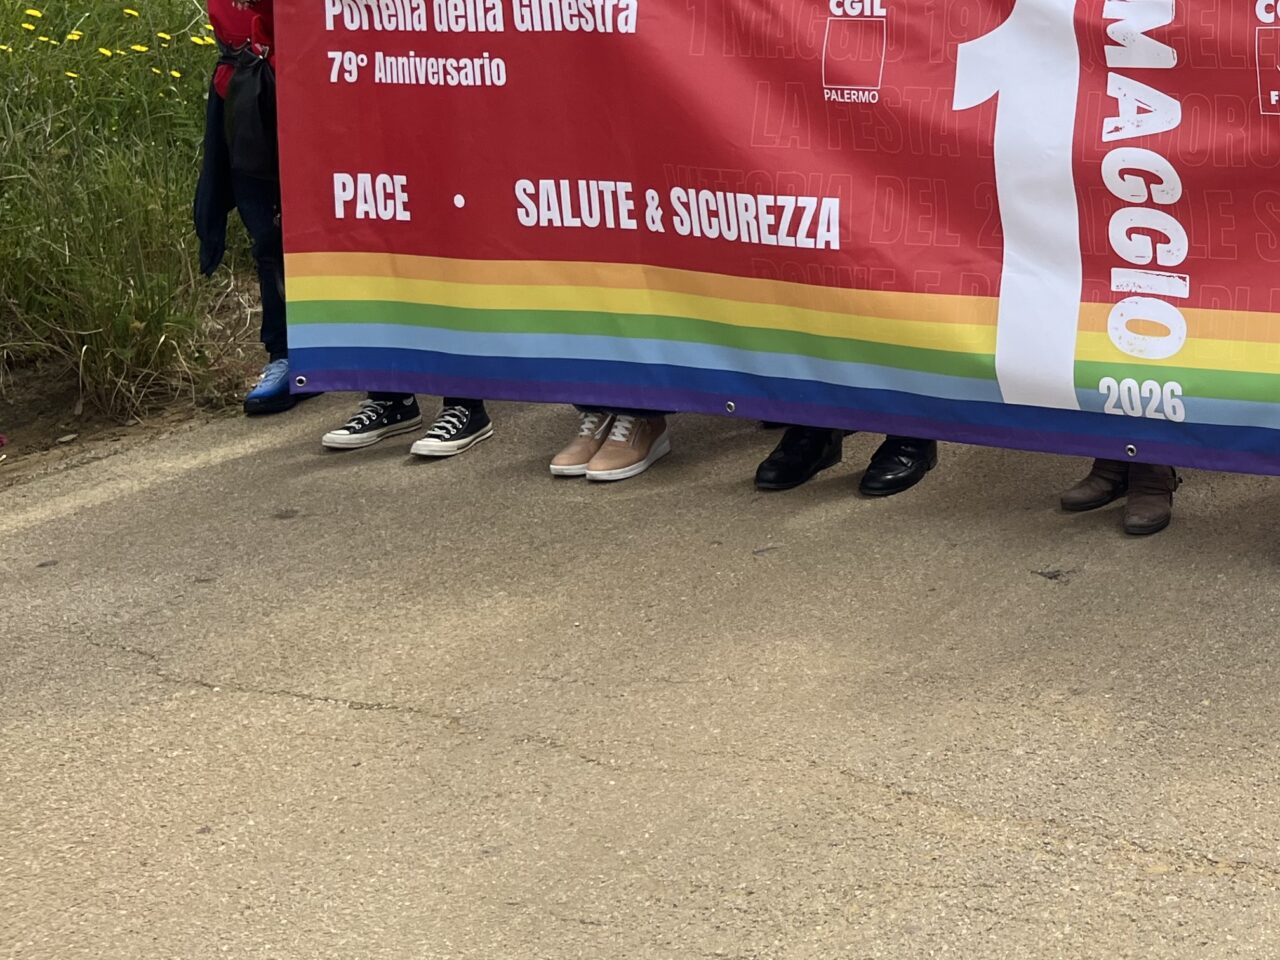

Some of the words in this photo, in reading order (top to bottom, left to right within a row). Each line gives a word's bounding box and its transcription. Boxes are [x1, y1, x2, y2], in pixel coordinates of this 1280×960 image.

[326, 49, 369, 84] 79°
[373, 49, 507, 87] Anniversario
[823, 88, 880, 104] PALERMO
[333, 172, 411, 222] PACE
[514, 178, 638, 231] SALUTE
[644, 188, 666, 234] &
[669, 185, 841, 251] SICUREZZA
[1098, 375, 1192, 424] 2026
